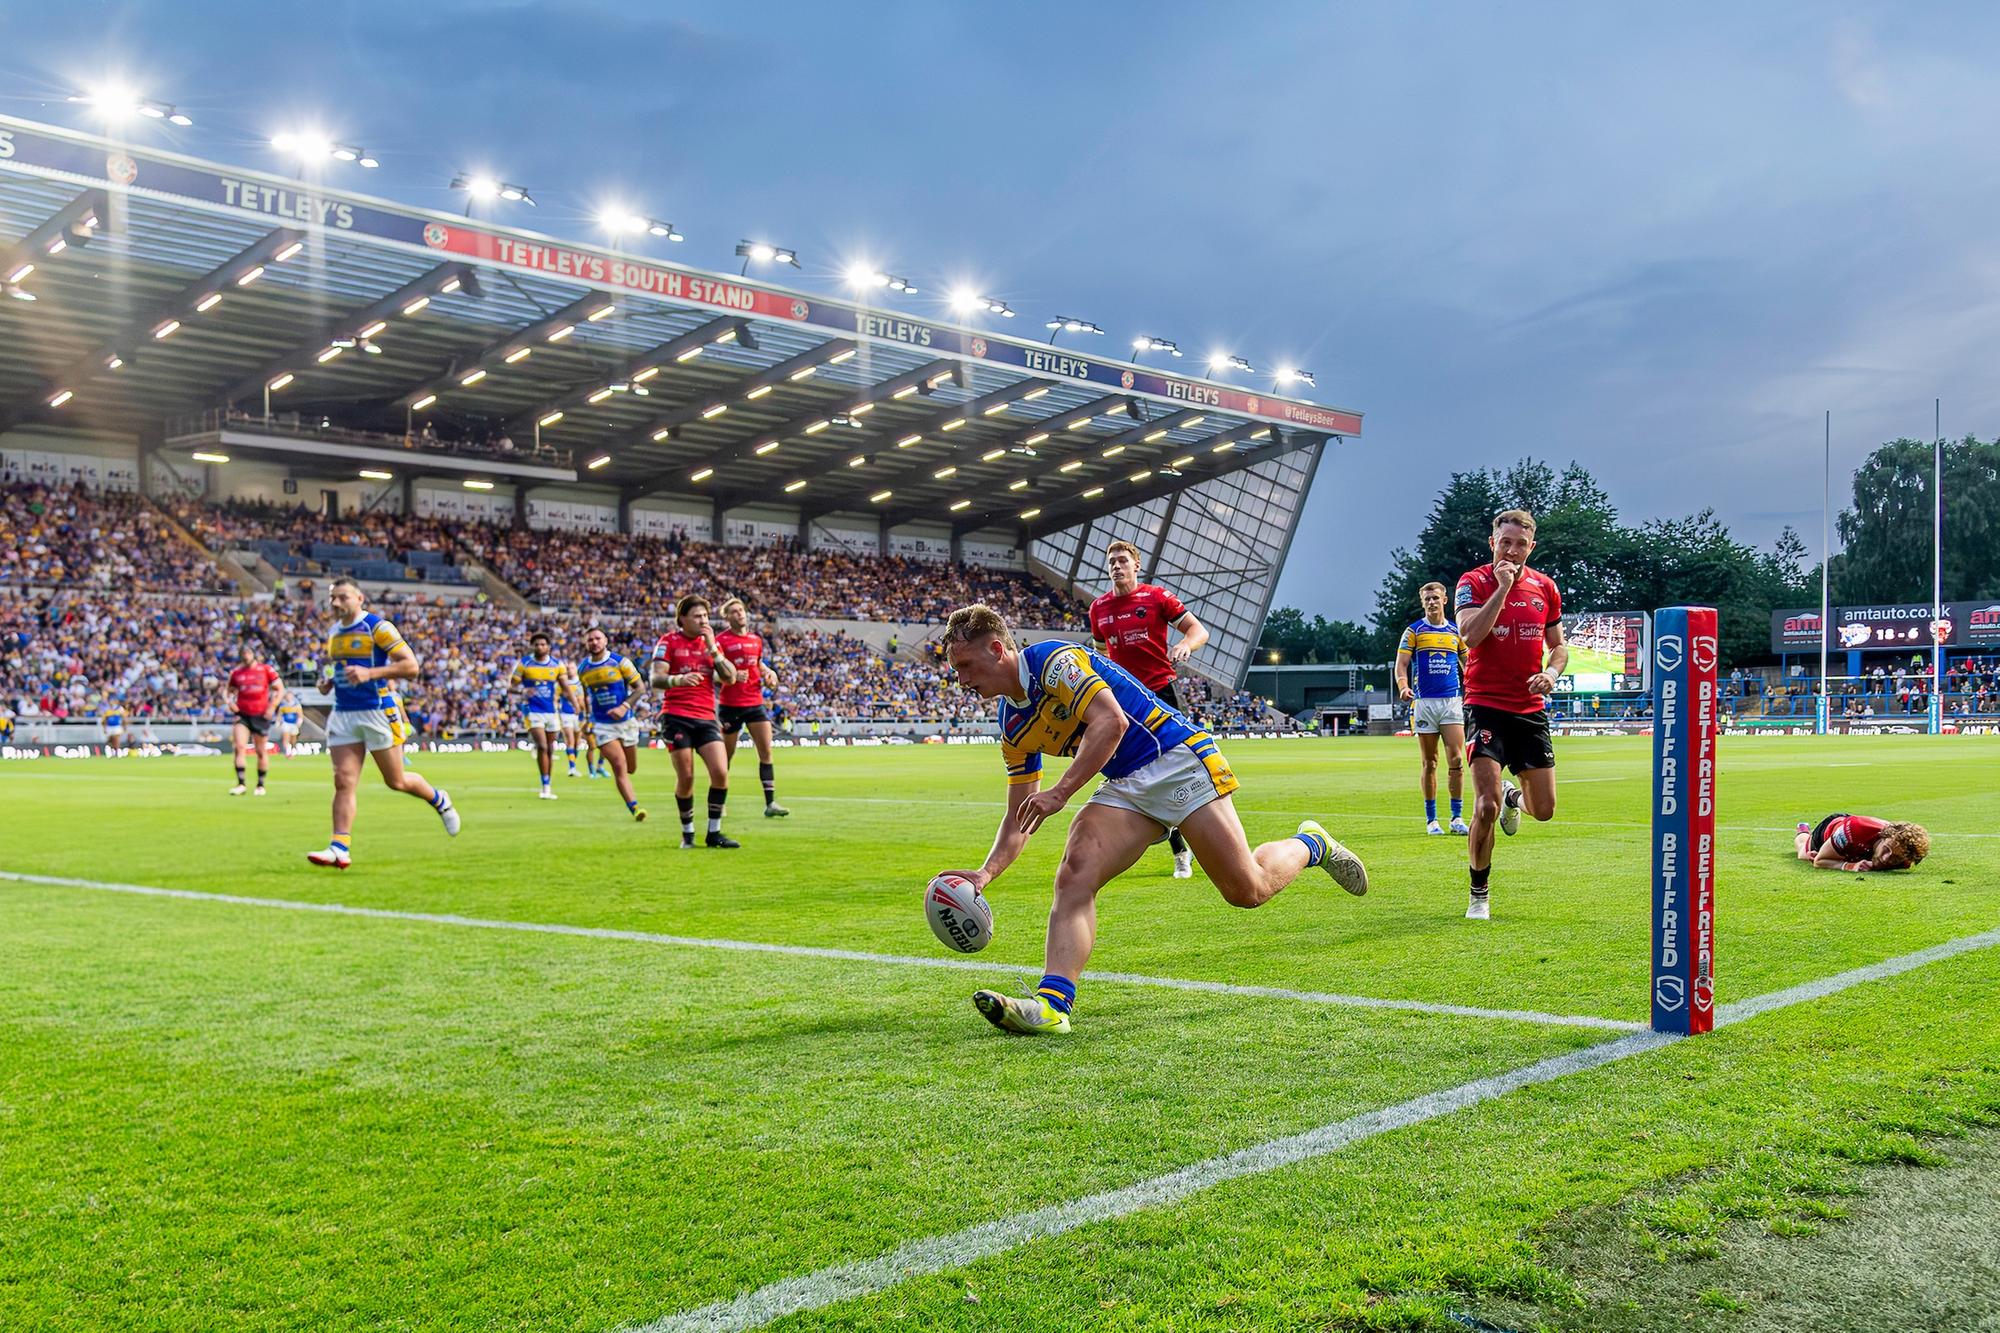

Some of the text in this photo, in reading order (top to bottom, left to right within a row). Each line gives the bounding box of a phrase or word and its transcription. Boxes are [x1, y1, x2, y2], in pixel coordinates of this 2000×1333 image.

[221, 178, 354, 229] TETLEY'S
[498, 239, 755, 311] TETLEY'S SOUTH STAND
[855, 313, 931, 346] TETLEY'S
[1025, 350, 1088, 378] TETLEY'S
[1166, 381, 1219, 405] TETLEY'S
[1285, 406, 1335, 426] @TetleysBeer
[1876, 628, 1895, 640] 18
[1908, 627, 1919, 639] 6
[1661, 680, 1677, 815] BETFRED
[1698, 681, 1712, 817] BETFRED
[1661, 833, 1678, 967] BETFRED
